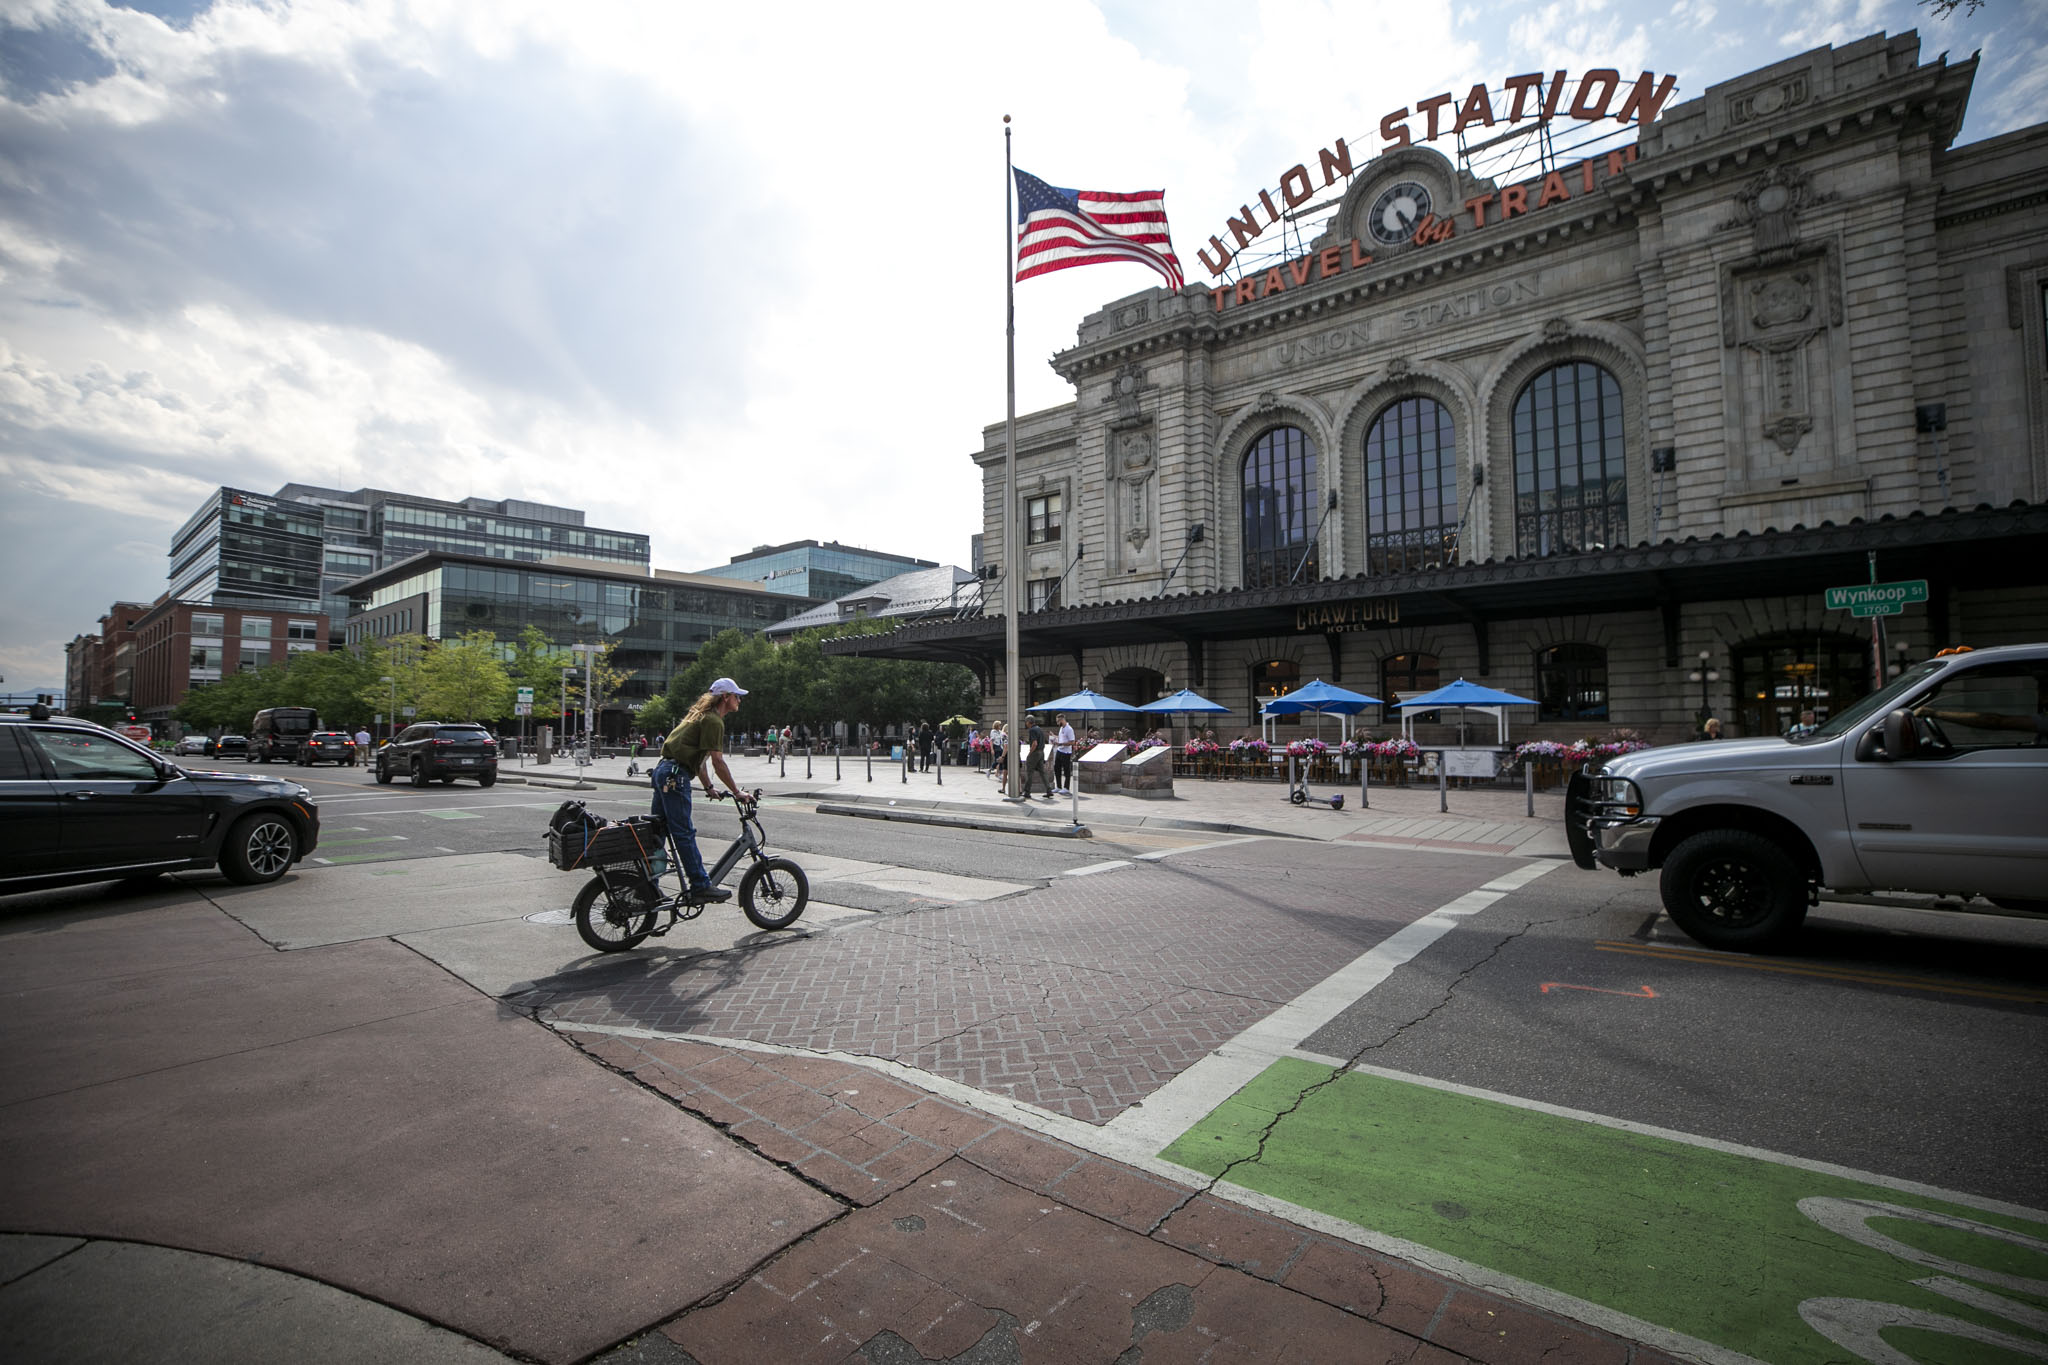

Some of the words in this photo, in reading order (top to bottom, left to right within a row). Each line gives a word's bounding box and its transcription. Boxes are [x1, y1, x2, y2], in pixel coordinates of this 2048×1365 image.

[1196, 137, 1353, 276] UNION
[1380, 68, 1677, 155] STATION
[1208, 238, 1373, 313] TRAVEL
[1411, 212, 1457, 246] by
[1465, 143, 1638, 229] TRAIN
[1276, 320, 1371, 364] UNION
[1401, 273, 1541, 332] STATION
[1831, 586, 1906, 605] Wynkoop
[1911, 586, 1923, 596] St
[1863, 605, 1890, 614] 1700
[1296, 598, 1400, 631] CRAWFORD
[1327, 623, 1369, 634] HOTEL
